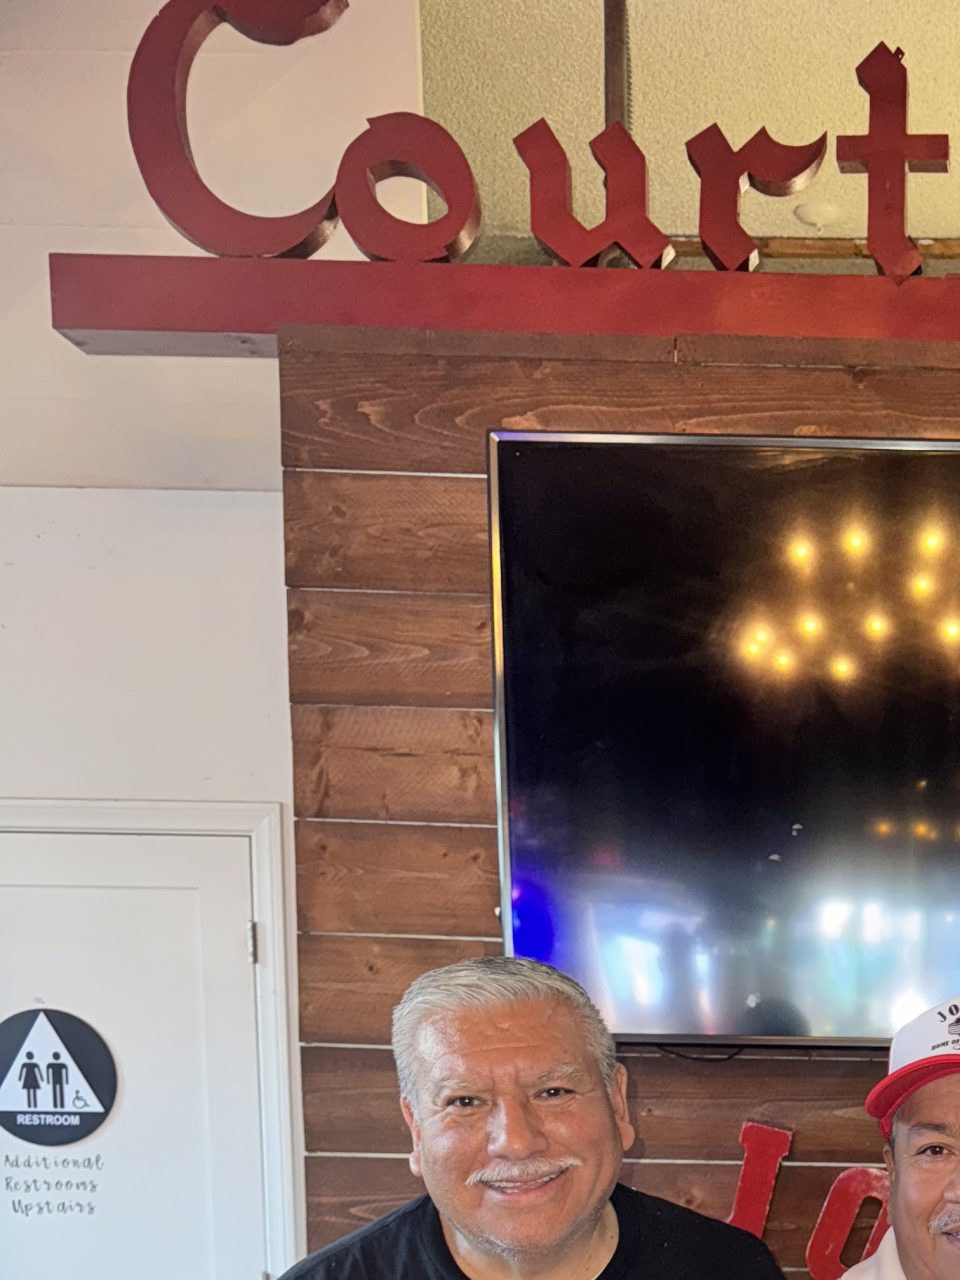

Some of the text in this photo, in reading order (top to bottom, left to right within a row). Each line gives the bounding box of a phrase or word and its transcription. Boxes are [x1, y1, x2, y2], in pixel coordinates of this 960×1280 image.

[126, 0, 950, 285] Court
[16, 1113, 81, 1126] RESTROOM
[3, 1153, 105, 1171] Additional
[4, 1176, 99, 1193] Restrooms
[12, 1199, 97, 1217] Upstairs
